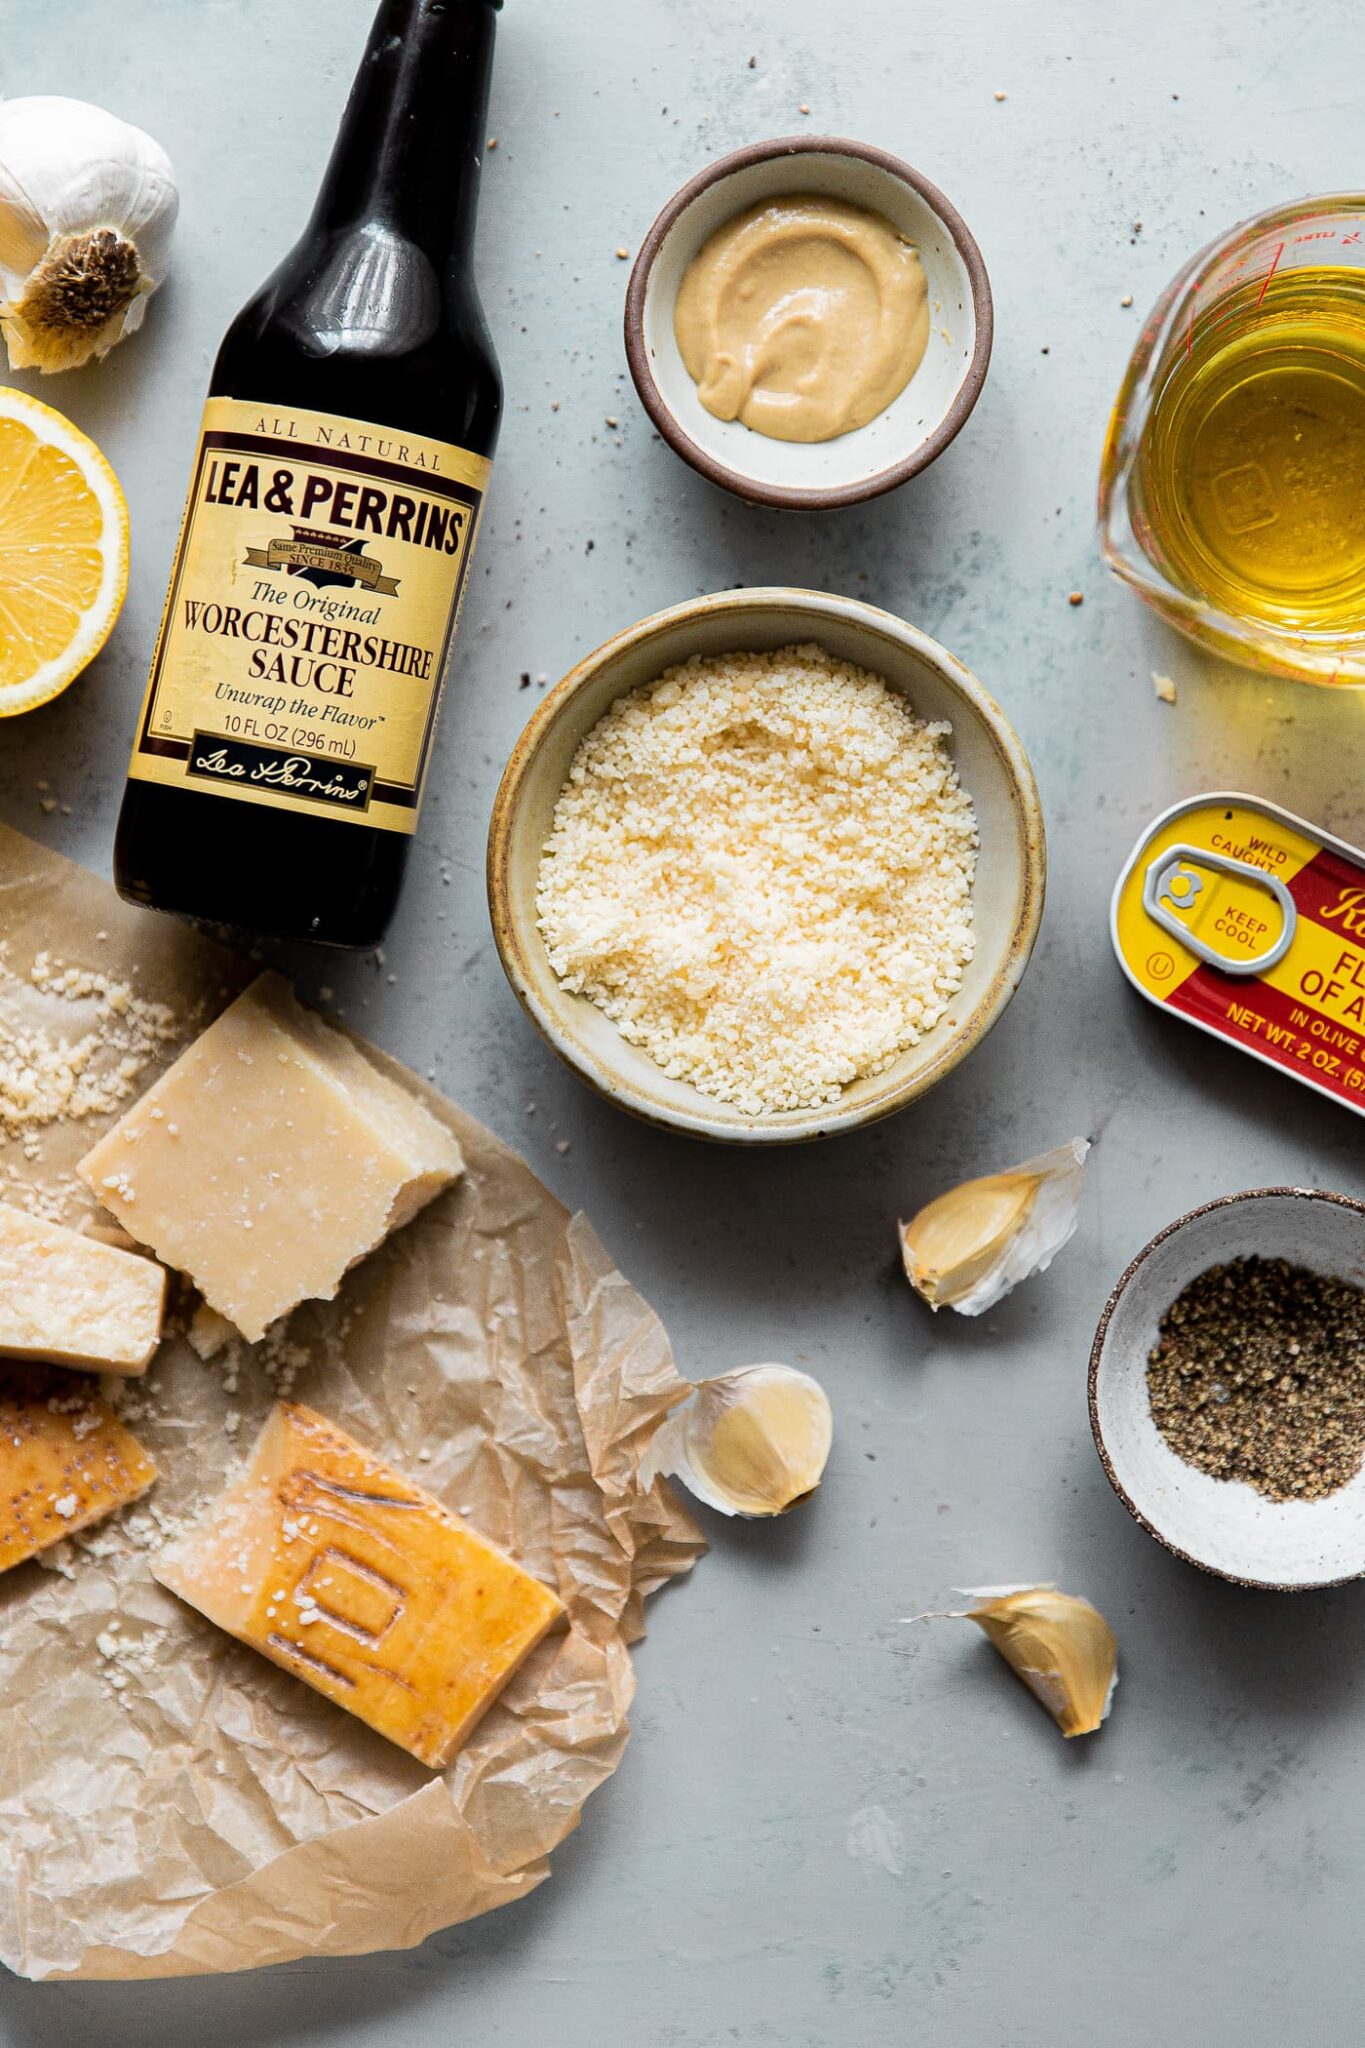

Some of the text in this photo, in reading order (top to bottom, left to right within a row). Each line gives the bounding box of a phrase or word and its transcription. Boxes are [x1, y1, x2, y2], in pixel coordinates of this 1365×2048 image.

[255, 417, 441, 471] ALL NATURAL
[204, 460, 464, 556] LEA & PERRINS
[272, 541, 380, 573] Same Premium Quality
[289, 553, 327, 567] SINCE
[250, 580, 382, 625] The Original
[183, 600, 434, 681] WORCESTERSHIRE
[248, 648, 357, 698] SAUCE
[214, 682, 287, 715] Unwrap
[288, 699, 319, 718] the
[224, 714, 356, 759] 10 FL OZ (296 mL)
[196, 749, 246, 775] Lea
[1211, 834, 1276, 873] CAUGHT
[1249, 836, 1288, 864] WILD
[1214, 919, 1256, 950] COOL
[1225, 906, 1268, 934] KEEP
[1300, 970, 1365, 1026] OF A
[1226, 1002, 1266, 1033] NET
[1265, 1022, 1297, 1053] WT.
[1296, 1042, 1312, 1060] 2
[1312, 1049, 1341, 1078] OZ.
[1288, 1008, 1310, 1028] IN
[1310, 1020, 1360, 1056] OLIVE
